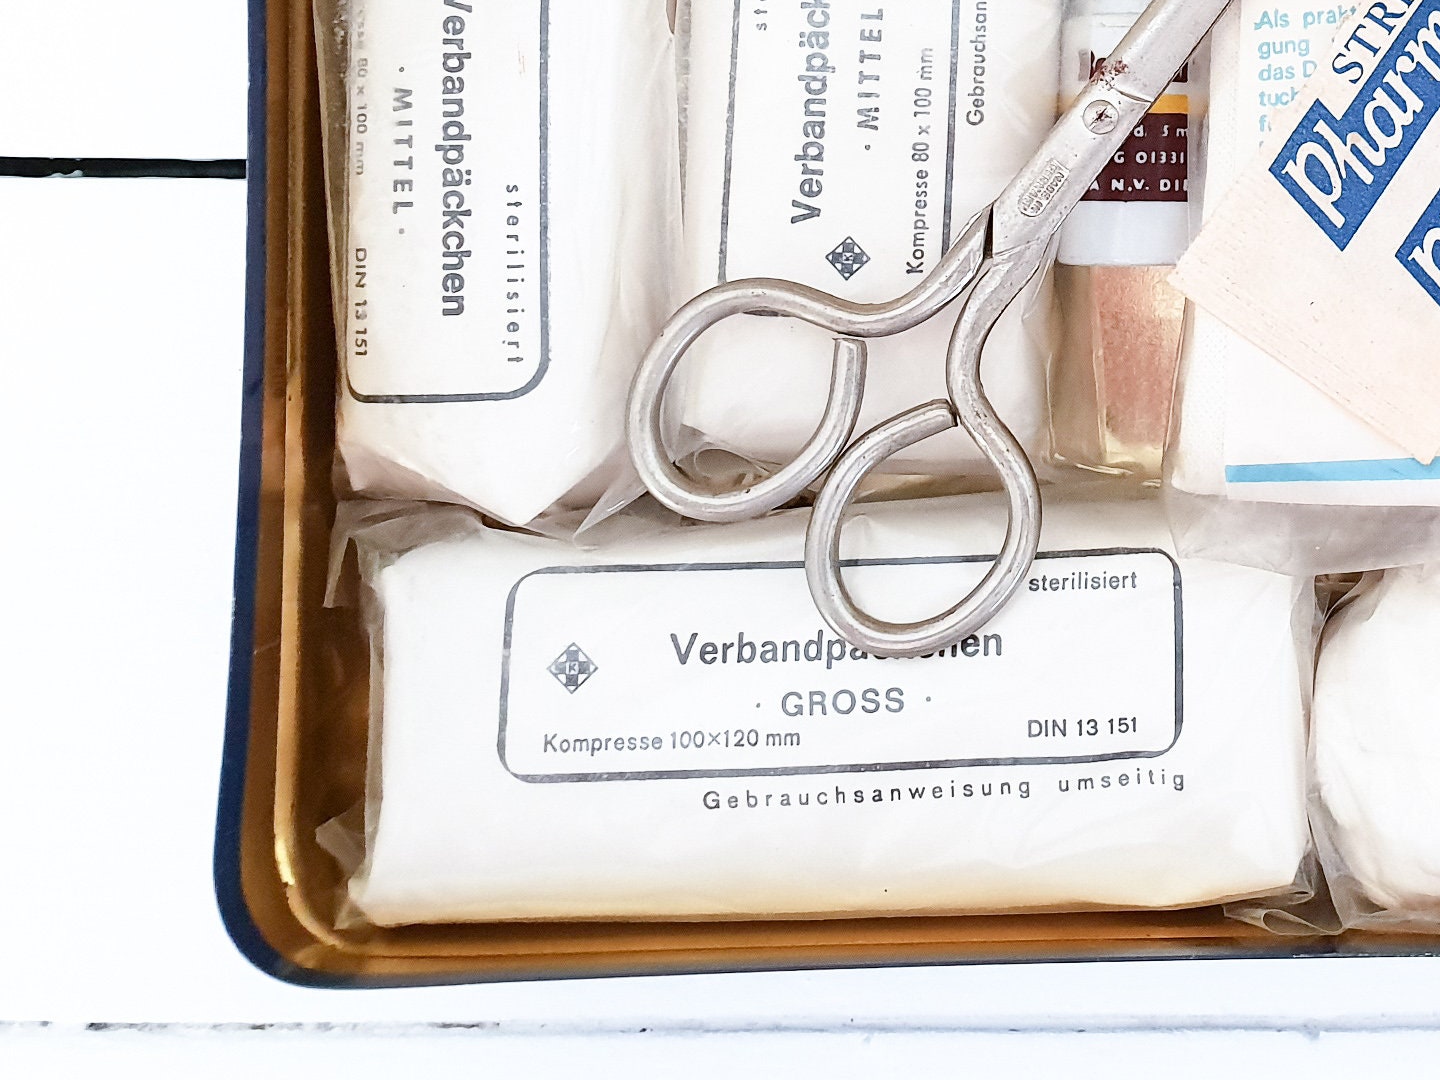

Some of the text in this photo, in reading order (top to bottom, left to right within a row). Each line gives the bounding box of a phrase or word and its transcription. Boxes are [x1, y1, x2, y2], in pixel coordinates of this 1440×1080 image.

[1254, 8, 1291, 30] Als
[920, 47, 934, 81] mm
[1258, 39, 1310, 60] gung
[857, 8, 884, 131] MITTEL
[1258, 63, 1296, 81] das
[914, 87, 932, 118] 100
[356, 104, 369, 135] 100
[354, 138, 365, 176] mm
[392, 87, 414, 215] MITTEL
[912, 142, 930, 162] 80
[1111, 178, 1150, 192] N.V.
[906, 169, 929, 275] Kompresse
[355, 248, 368, 289] DIN
[506, 184, 525, 363] sterilisiert
[355, 329, 368, 356] 151
[1028, 571, 1138, 592] sterilisiert
[670, 629, 1003, 669] Verbandpen
[781, 687, 905, 717] GROSS
[543, 732, 664, 757] Kompresse
[765, 732, 801, 747] mm
[1027, 719, 1067, 738] DIN
[1077, 719, 1098, 737] 13
[1107, 716, 1138, 735] 151
[702, 768, 1185, 811] Gebrauchsanweisung umseitig
